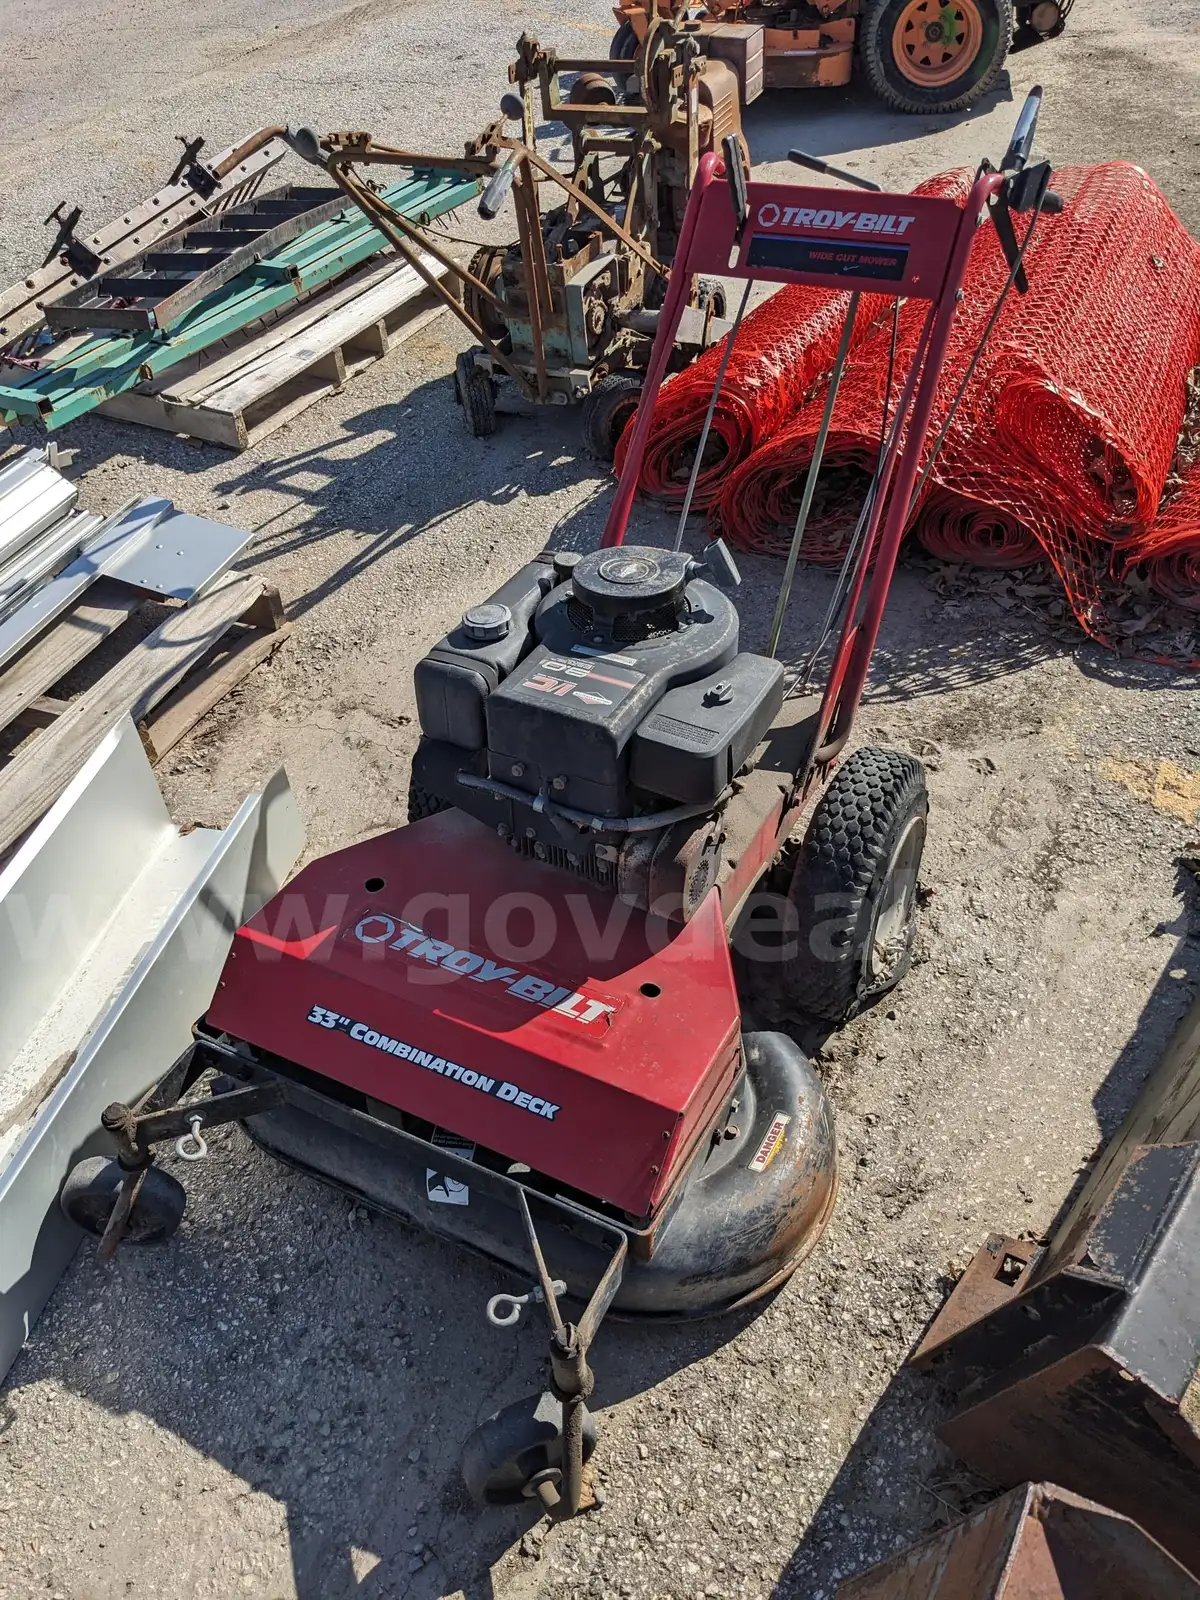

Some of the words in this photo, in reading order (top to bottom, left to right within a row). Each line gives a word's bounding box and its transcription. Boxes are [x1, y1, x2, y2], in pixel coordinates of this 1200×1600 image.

[780, 206, 915, 235] TROY-BILT
[809, 251, 833, 261] WIDE
[835, 253, 858, 263] CUT
[859, 255, 897, 266] MOWER
[388, 928, 616, 1024] TROY-BILT
[307, 1005, 350, 1029] 33"
[350, 1022, 495, 1093] COMBINATION
[496, 1081, 560, 1120] DECK
[755, 1121, 784, 1164] DANGER
